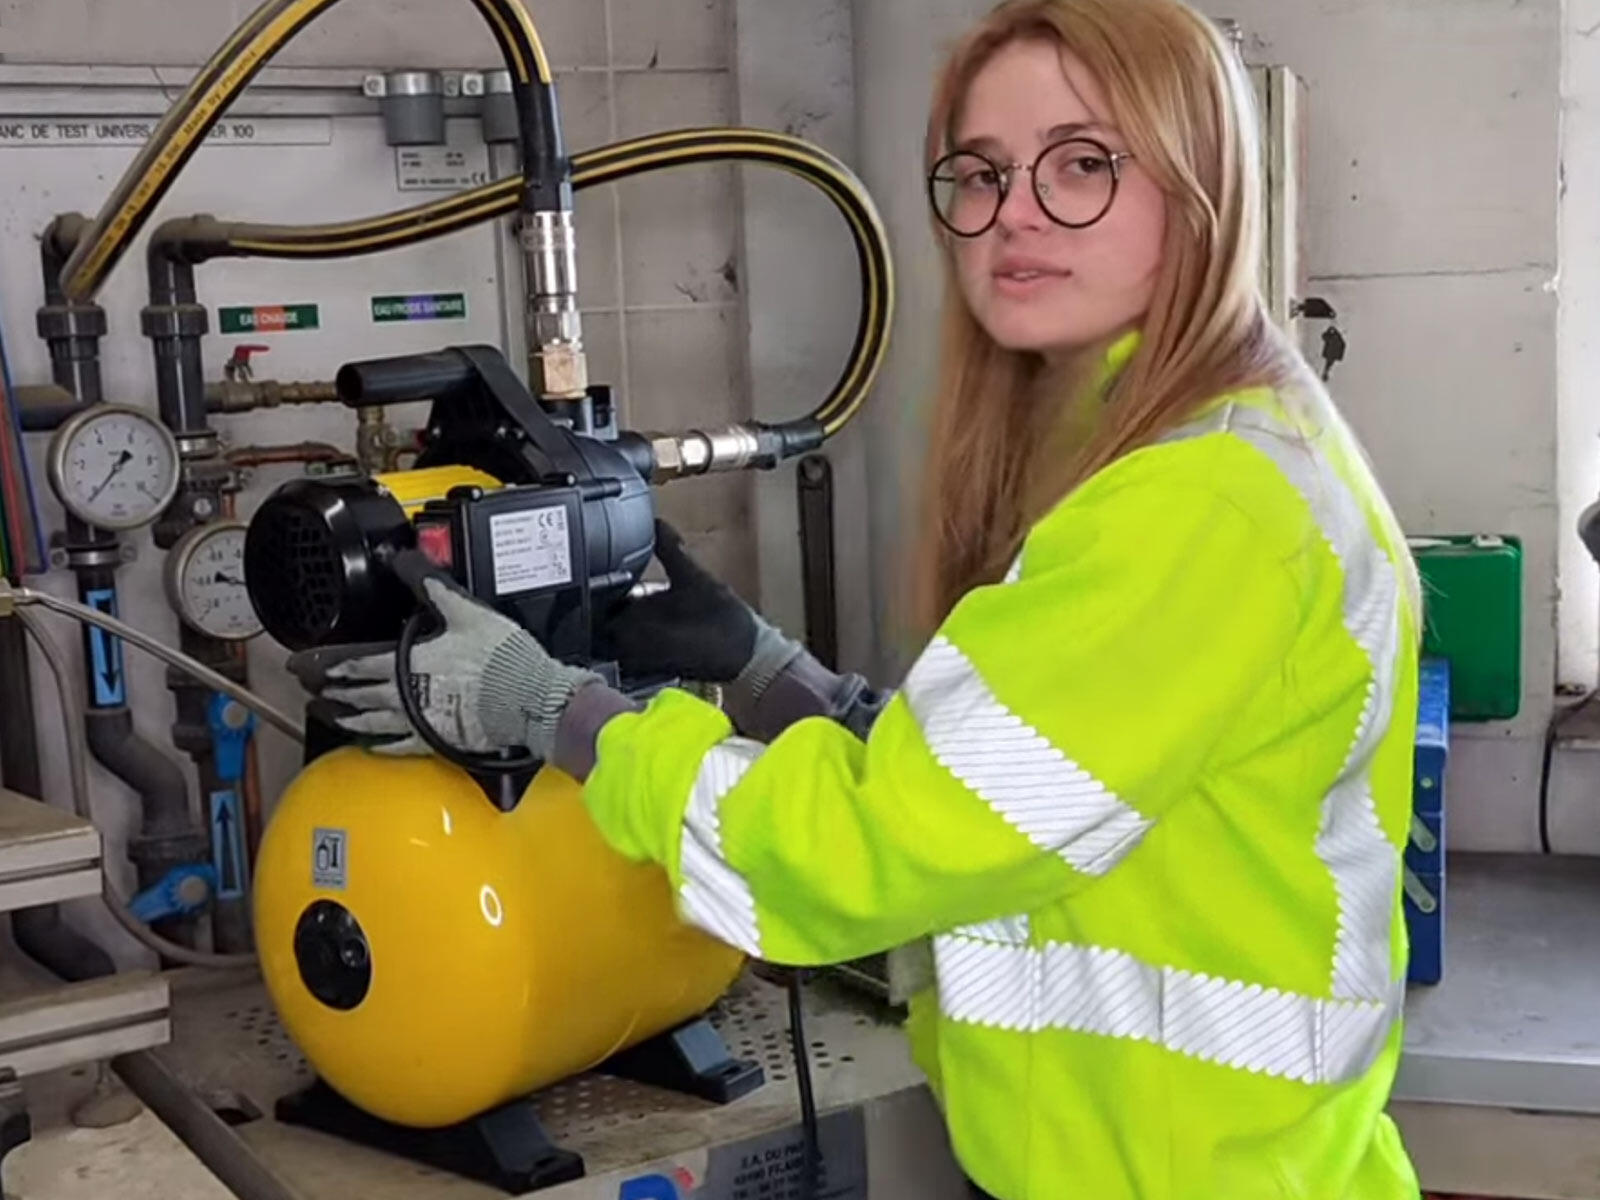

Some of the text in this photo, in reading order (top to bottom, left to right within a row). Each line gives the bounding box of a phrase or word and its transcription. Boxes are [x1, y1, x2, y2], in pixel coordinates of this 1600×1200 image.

[31, 124, 50, 139] DE
[57, 124, 88, 139] TEST
[233, 124, 255, 139] 100
